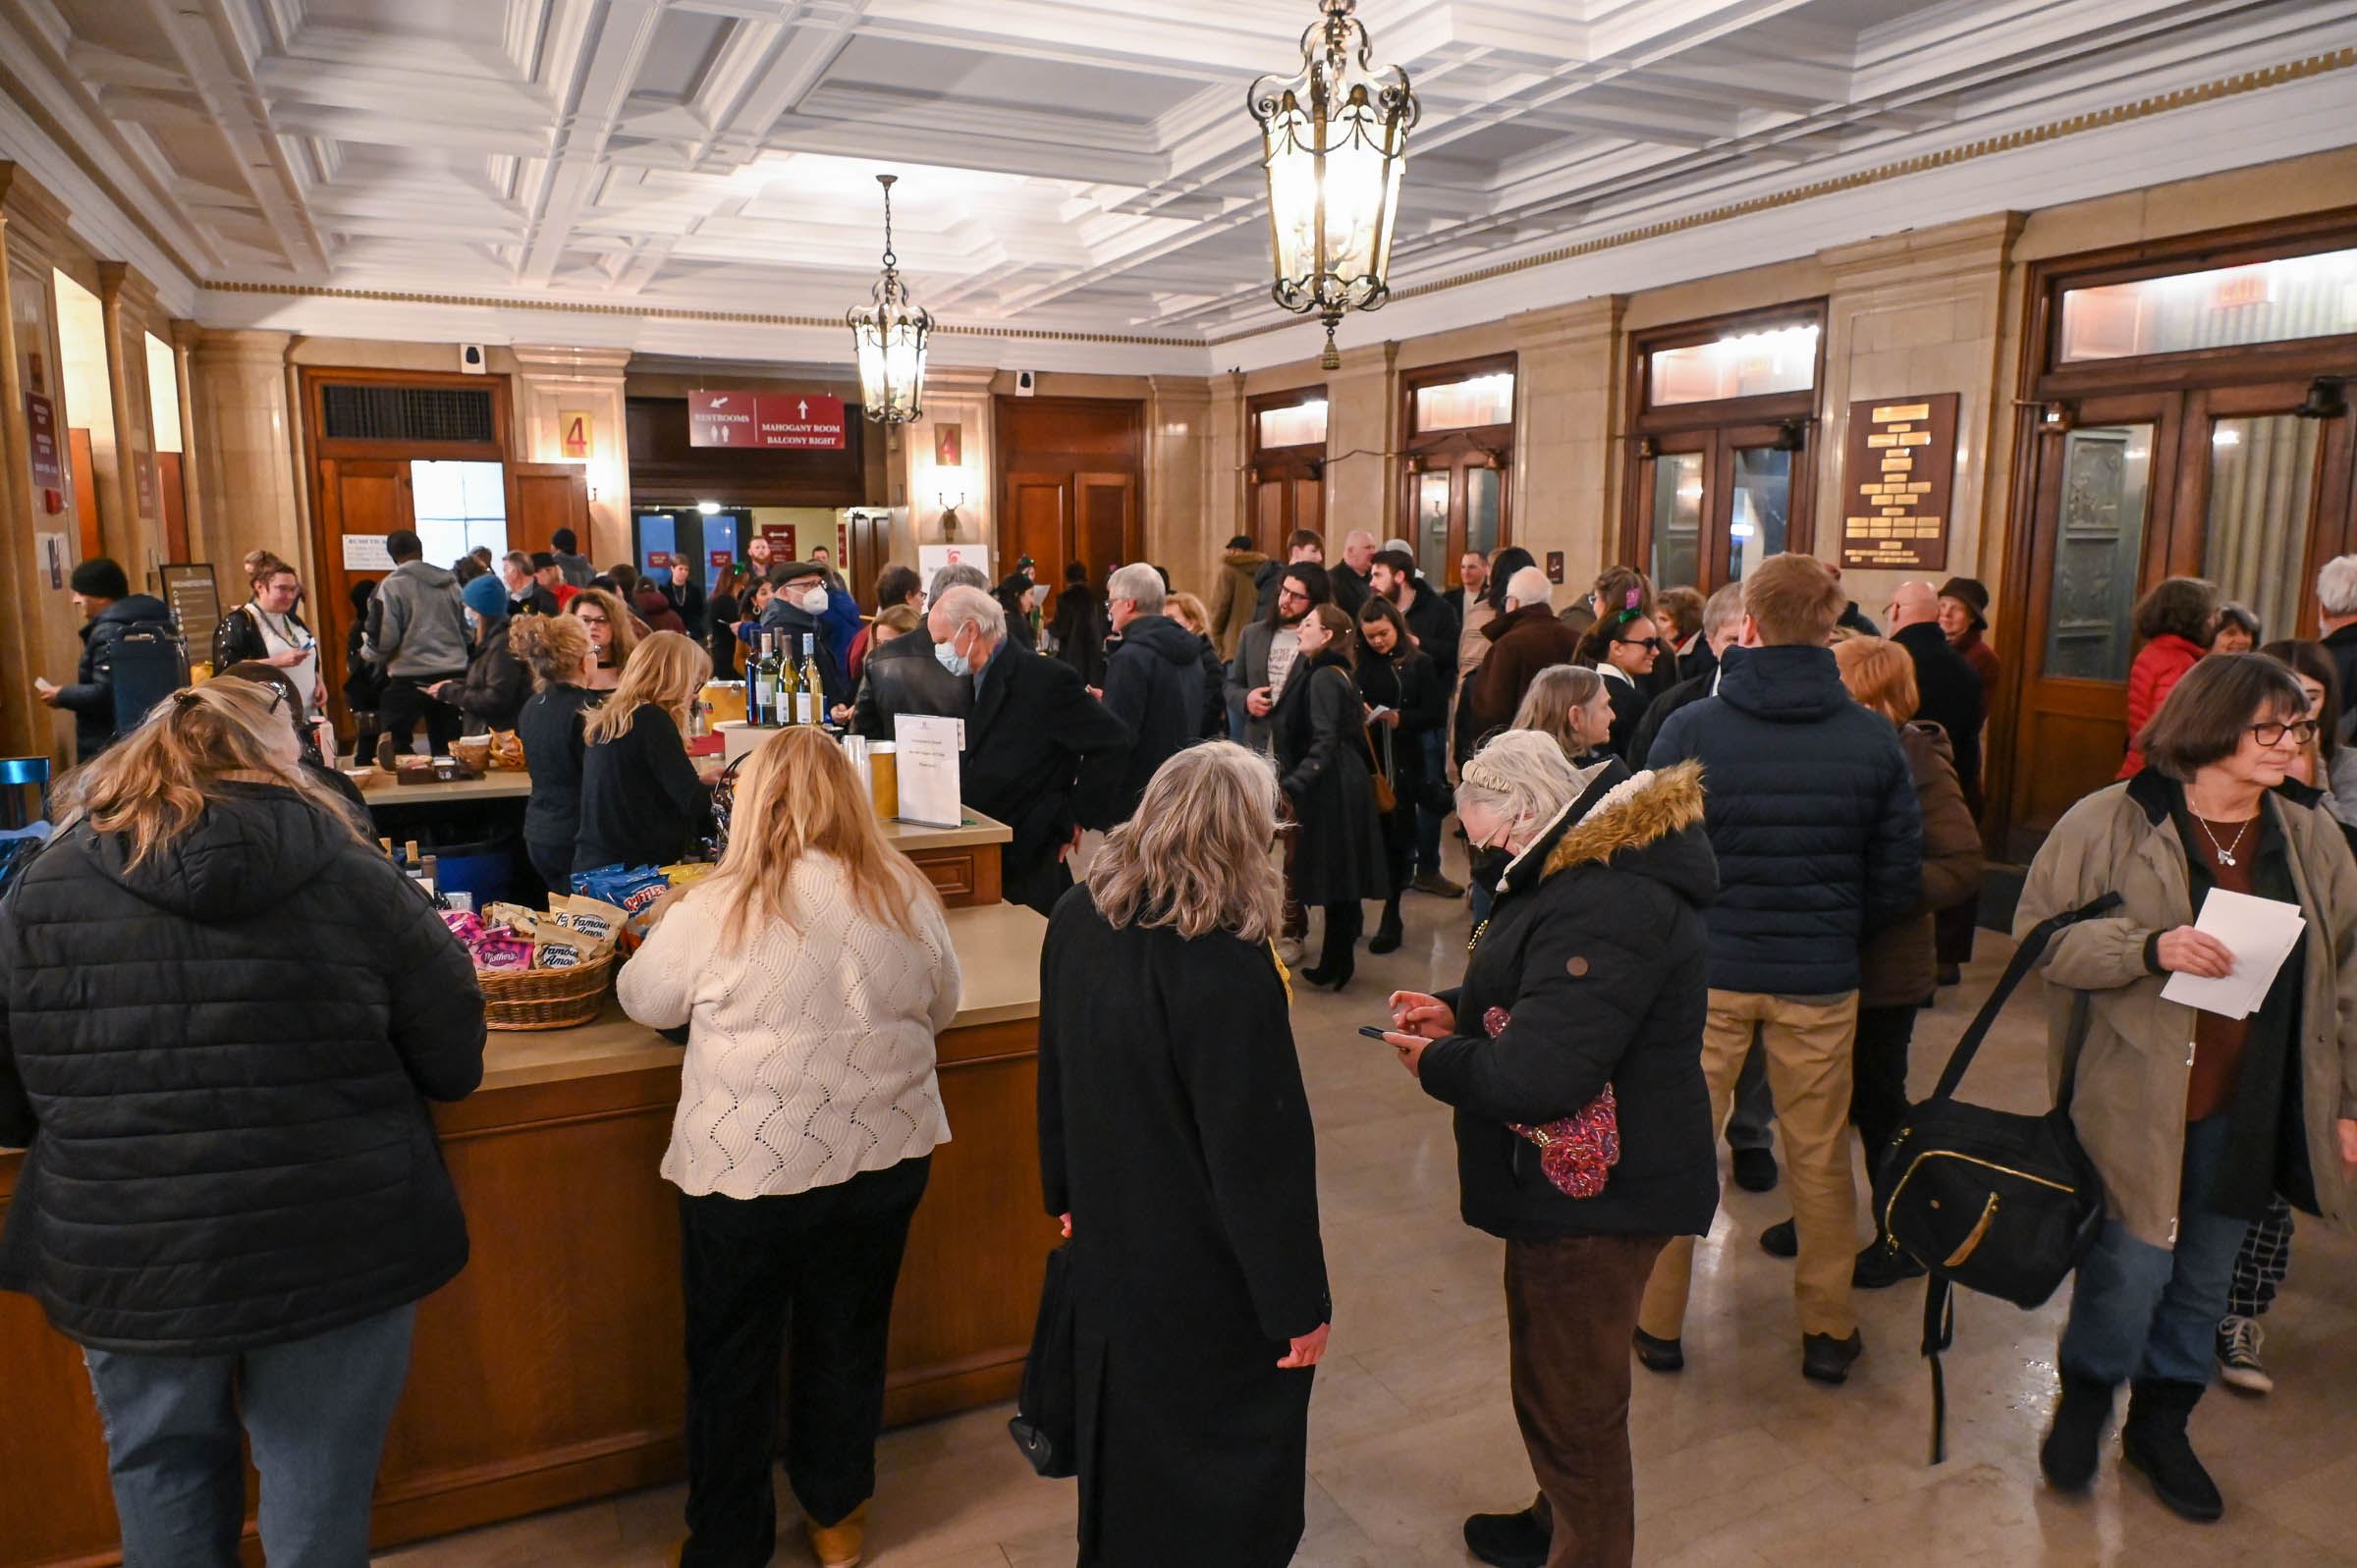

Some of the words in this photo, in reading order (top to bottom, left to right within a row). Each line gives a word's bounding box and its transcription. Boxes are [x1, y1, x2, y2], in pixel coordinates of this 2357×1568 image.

[694, 413, 749, 423] RESTROOMS
[566, 416, 587, 456] 4
[762, 423, 811, 433] MAHOGANY
[813, 424, 840, 433] ROOM
[767, 436, 806, 445] BALCONY
[808, 437, 836, 446] RIGHT
[939, 429, 959, 464] 4
[624, 884, 668, 913] RUFFLES
[572, 914, 611, 931] Famous
